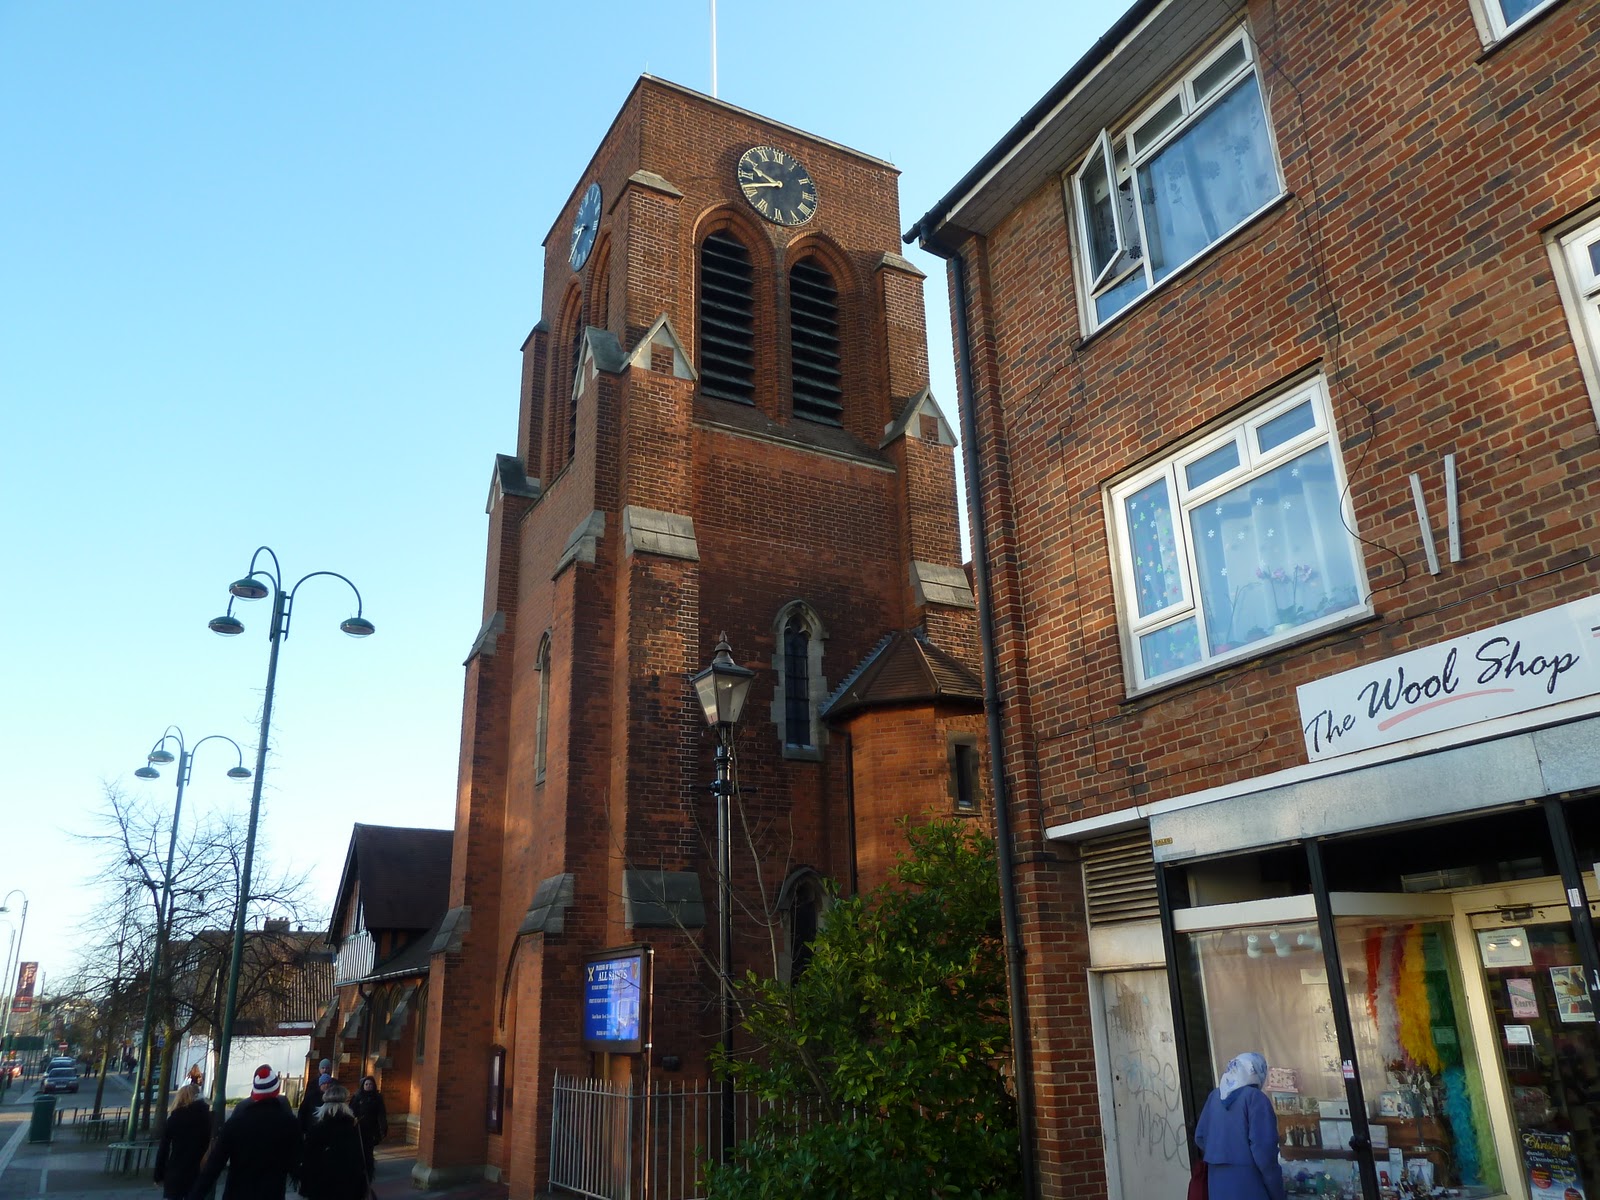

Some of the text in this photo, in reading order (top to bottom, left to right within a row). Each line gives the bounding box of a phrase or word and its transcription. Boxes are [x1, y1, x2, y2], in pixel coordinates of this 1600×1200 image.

[1304, 636, 1580, 753] The Wool Shop
[598, 971, 608, 982] ALL
